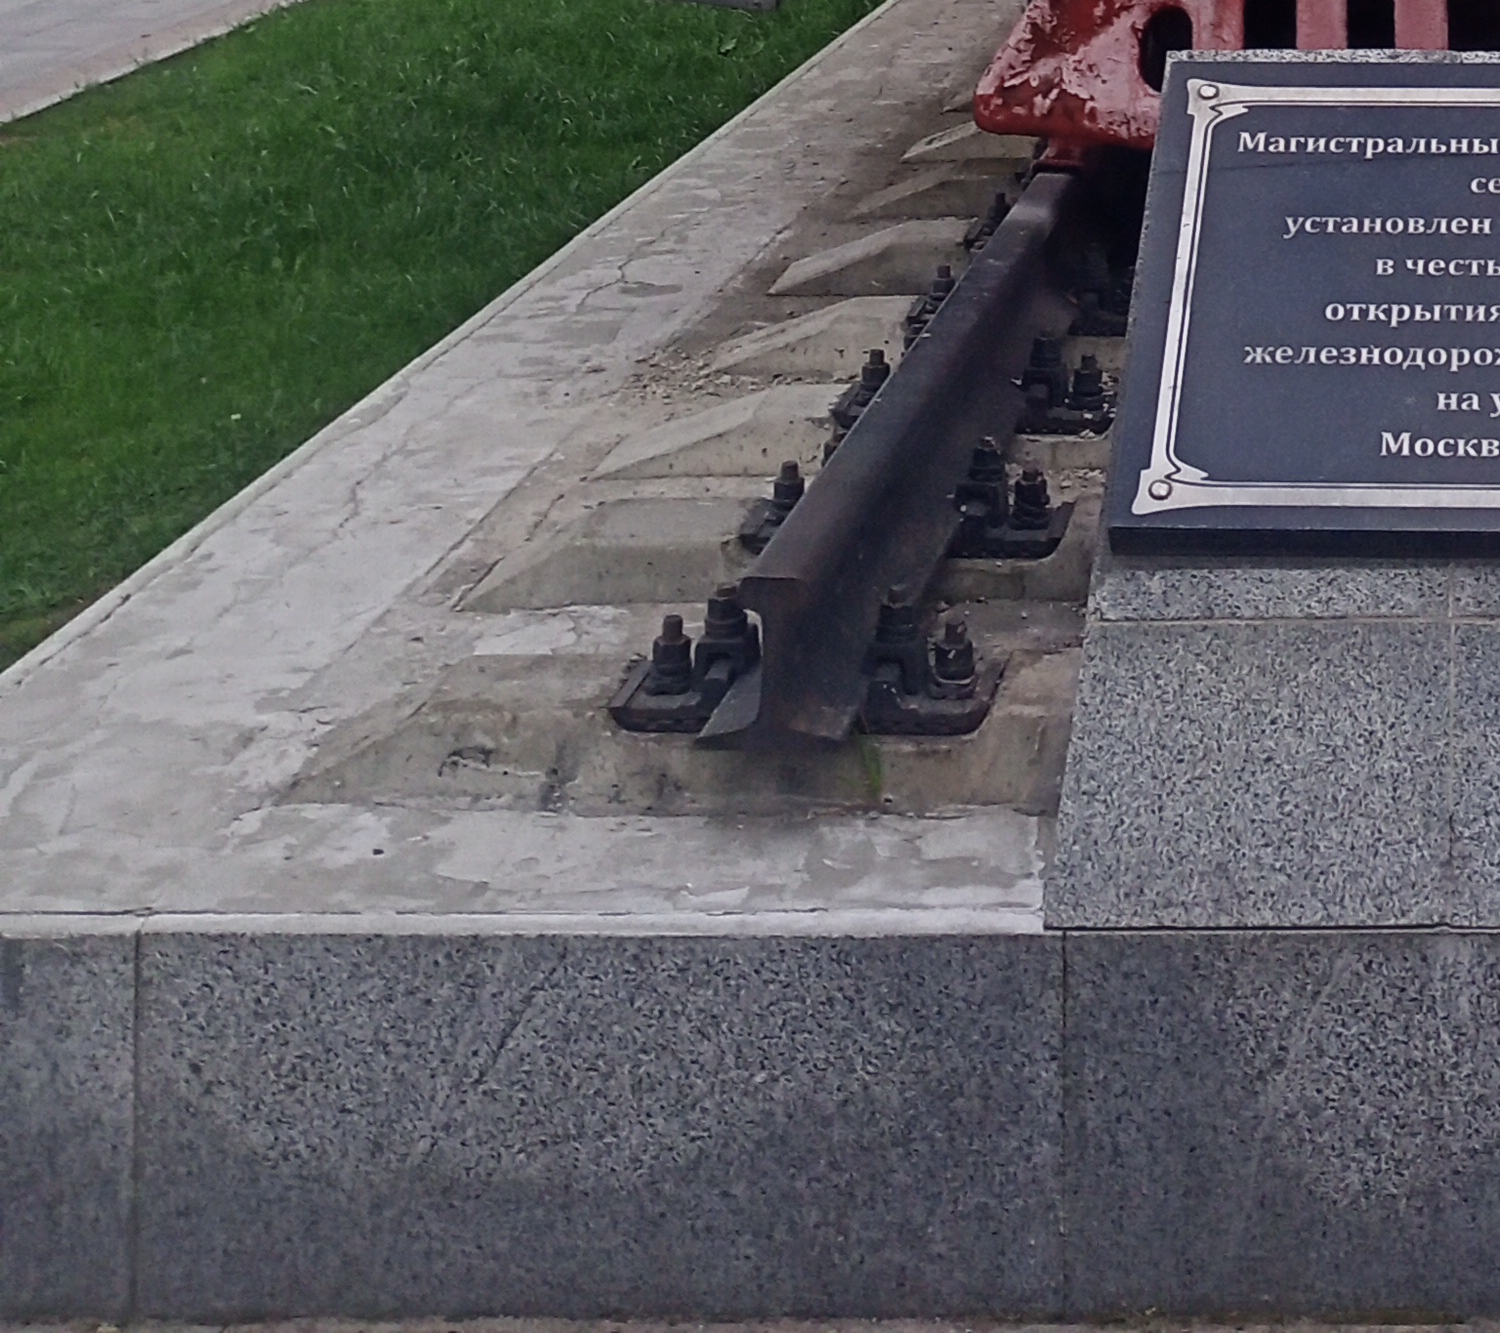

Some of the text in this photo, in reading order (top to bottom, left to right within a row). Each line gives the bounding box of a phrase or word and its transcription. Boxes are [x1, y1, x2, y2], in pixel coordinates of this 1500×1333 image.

[1282, 216, 1492, 239] установлен
[1376, 258, 1395, 276] в
[1436, 392, 1481, 411] на
